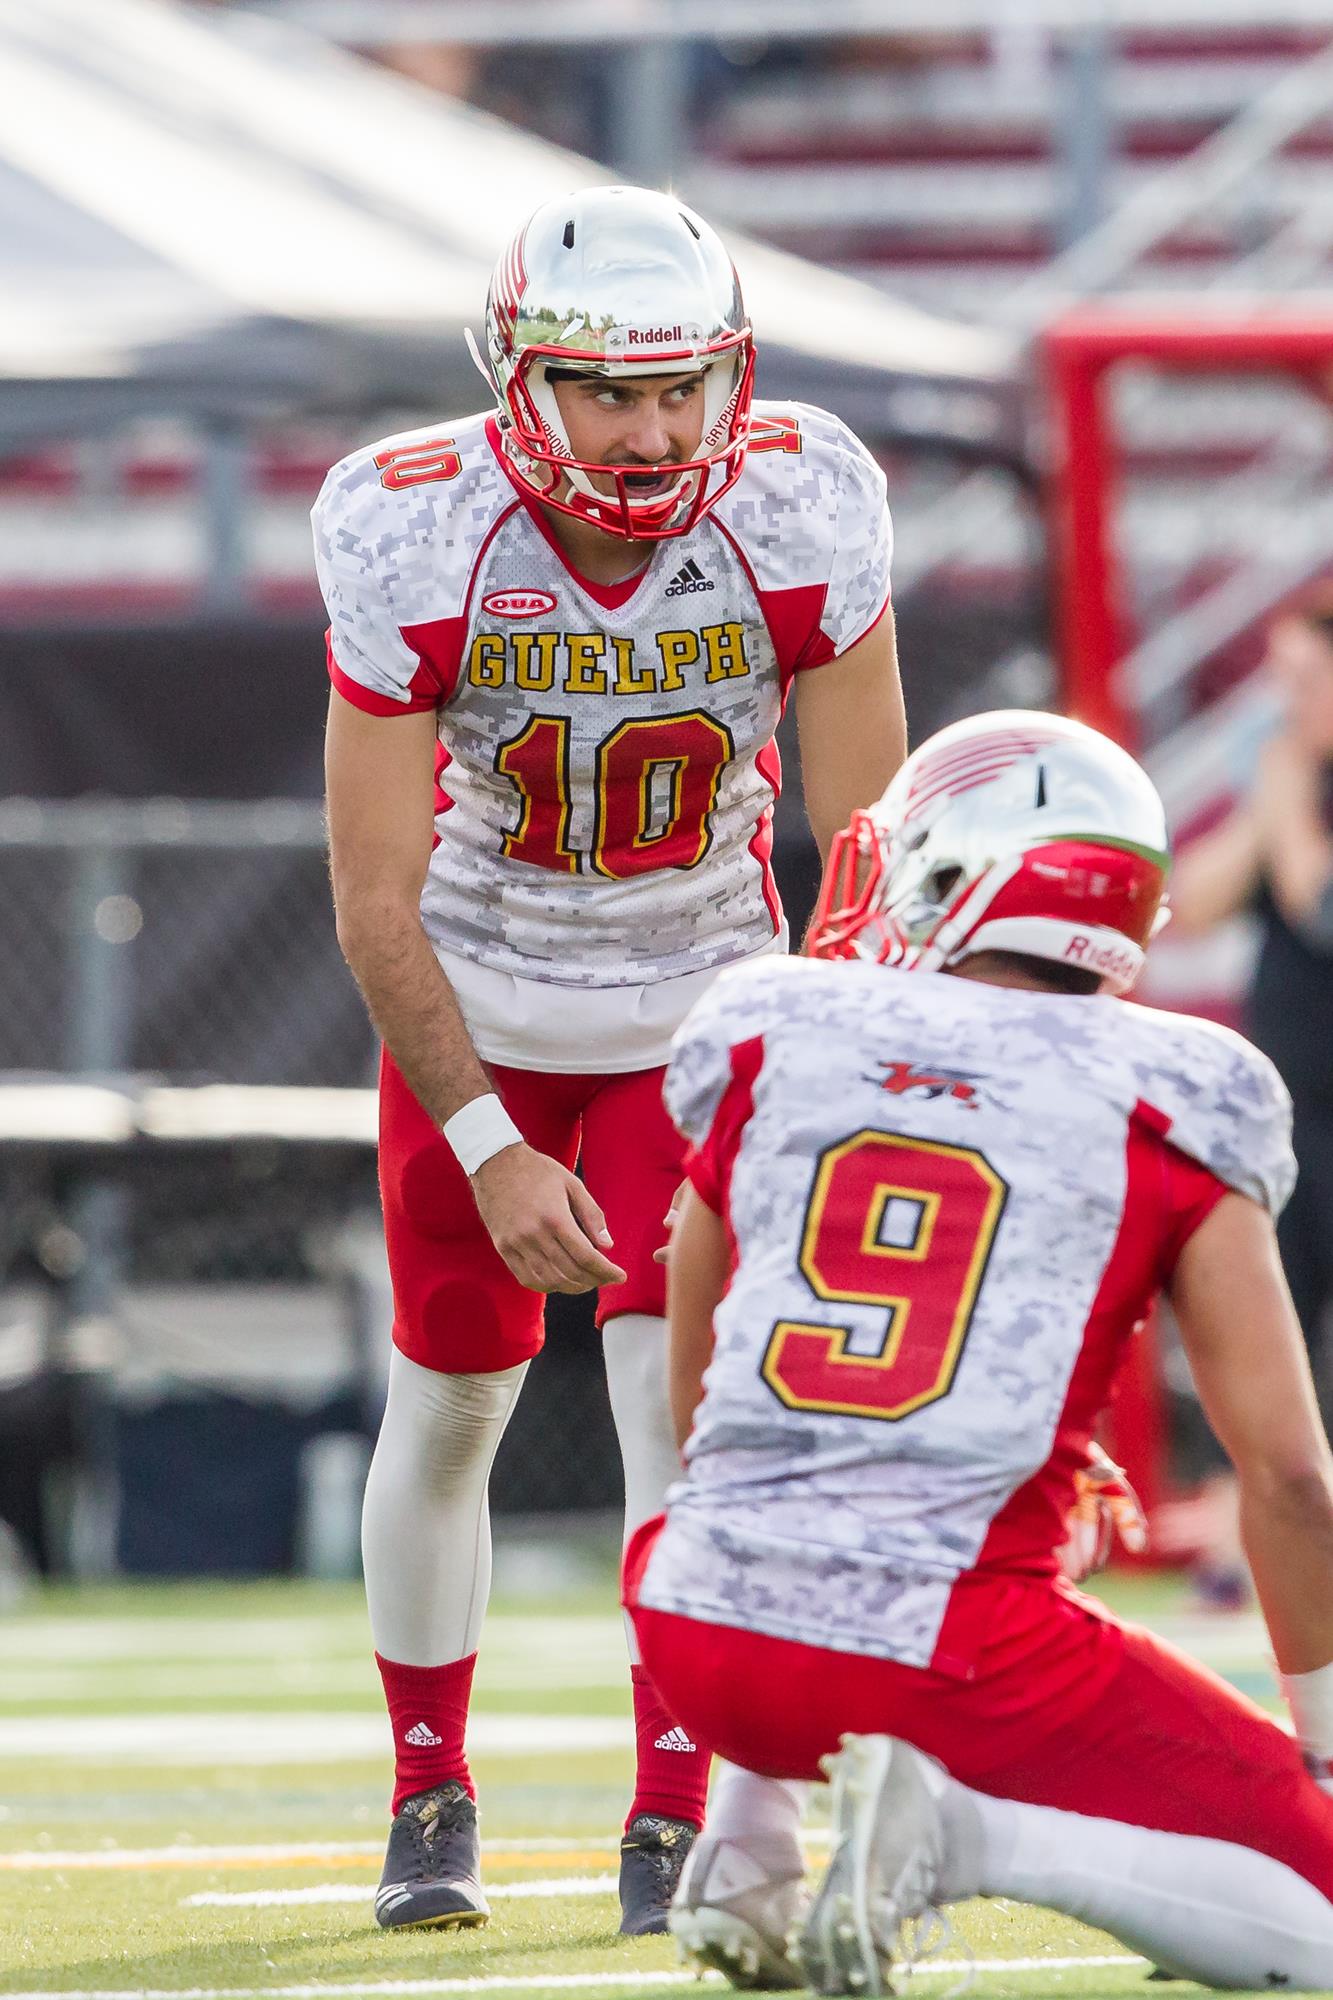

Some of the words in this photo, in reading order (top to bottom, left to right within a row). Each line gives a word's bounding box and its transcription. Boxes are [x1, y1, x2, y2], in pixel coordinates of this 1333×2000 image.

[628, 326, 682, 344] Riddell
[704, 386, 741, 447] GRYPHON
[373, 438, 463, 491] 10
[490, 598, 546, 610] OUA
[664, 579, 715, 597] adidas
[467, 621, 750, 695] GUELPH
[493, 707, 735, 880] 10
[760, 1128, 1011, 1423] 9
[404, 1733, 443, 1746] adidas
[654, 1739, 697, 1752] adidas
